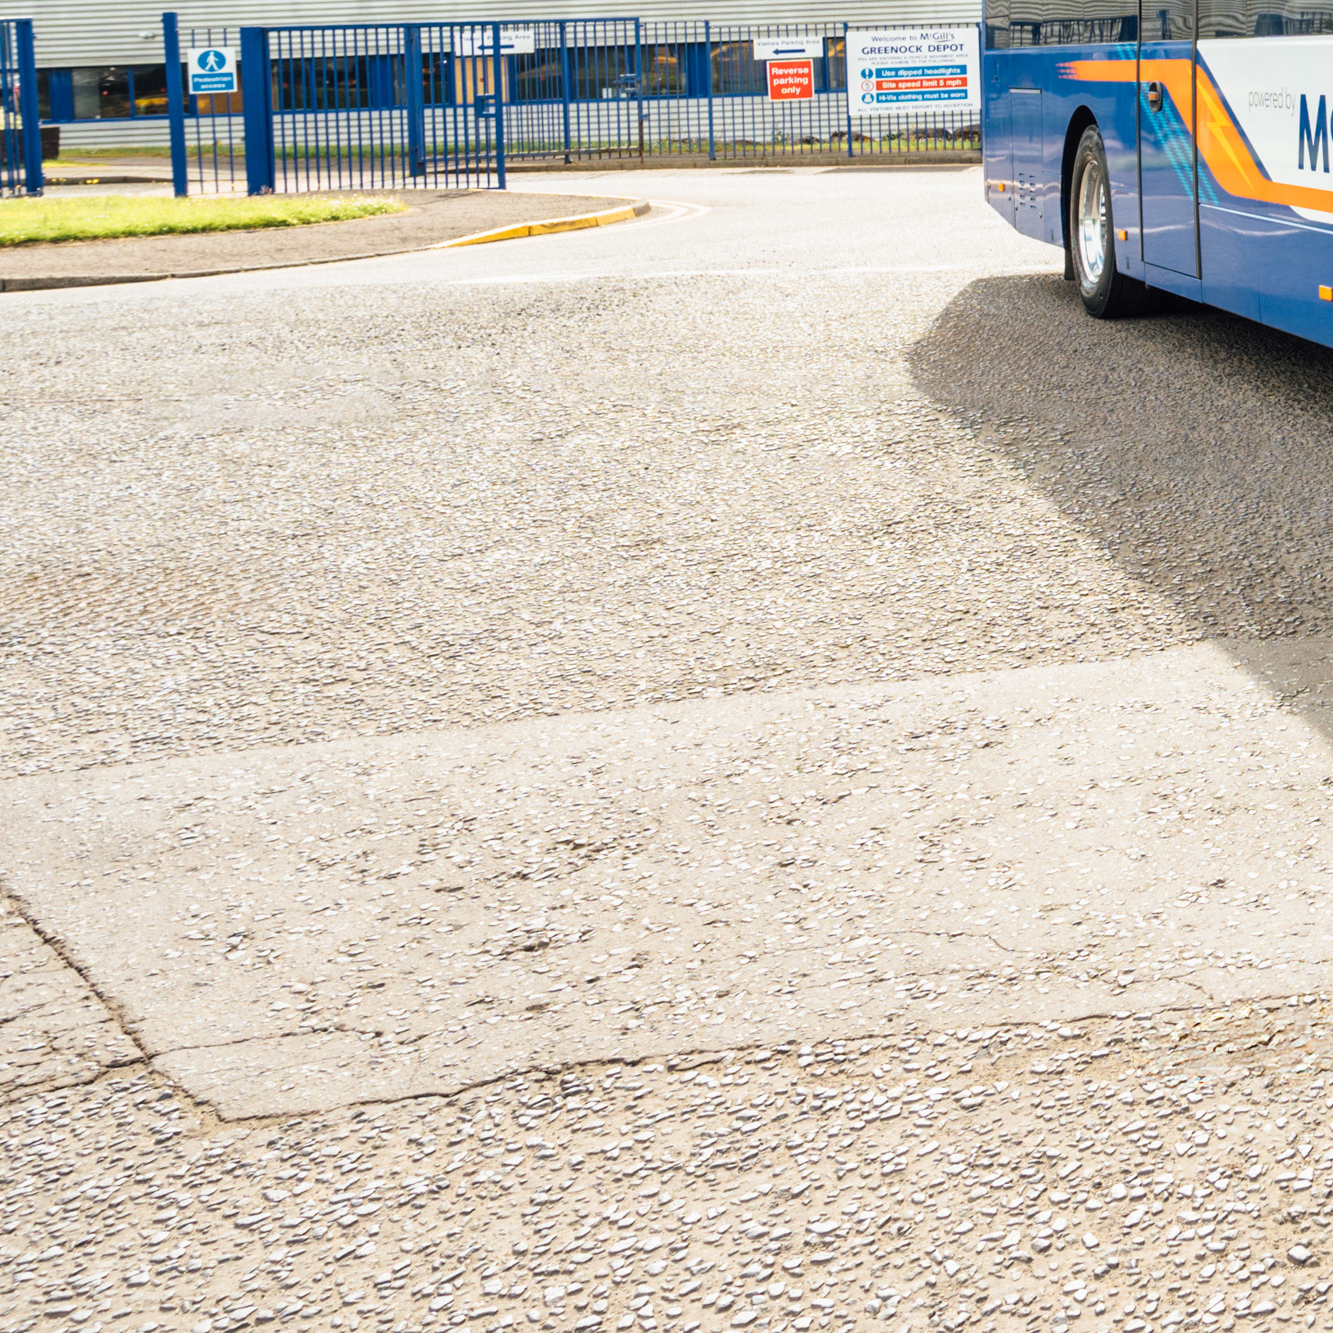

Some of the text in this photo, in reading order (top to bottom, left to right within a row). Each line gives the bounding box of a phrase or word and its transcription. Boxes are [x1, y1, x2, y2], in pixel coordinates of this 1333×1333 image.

[871, 34, 906, 42] Welcome
[920, 32, 955, 41] McGill's
[861, 43, 964, 55] GREENOCK DEPOT
[771, 67, 809, 75] Reverse
[882, 65, 960, 77] Use dipped headlights
[773, 76, 809, 86] parking
[882, 78, 896, 88] Site
[898, 79, 920, 89] speed
[922, 78, 937, 87] limit
[946, 78, 962, 88] mph
[781, 86, 801, 95] only
[898, 91, 922, 102] clothing
[924, 91, 939, 99] must
[941, 90, 948, 98] be
[1248, 87, 1283, 114] powered
[1285, 86, 1296, 117] by
